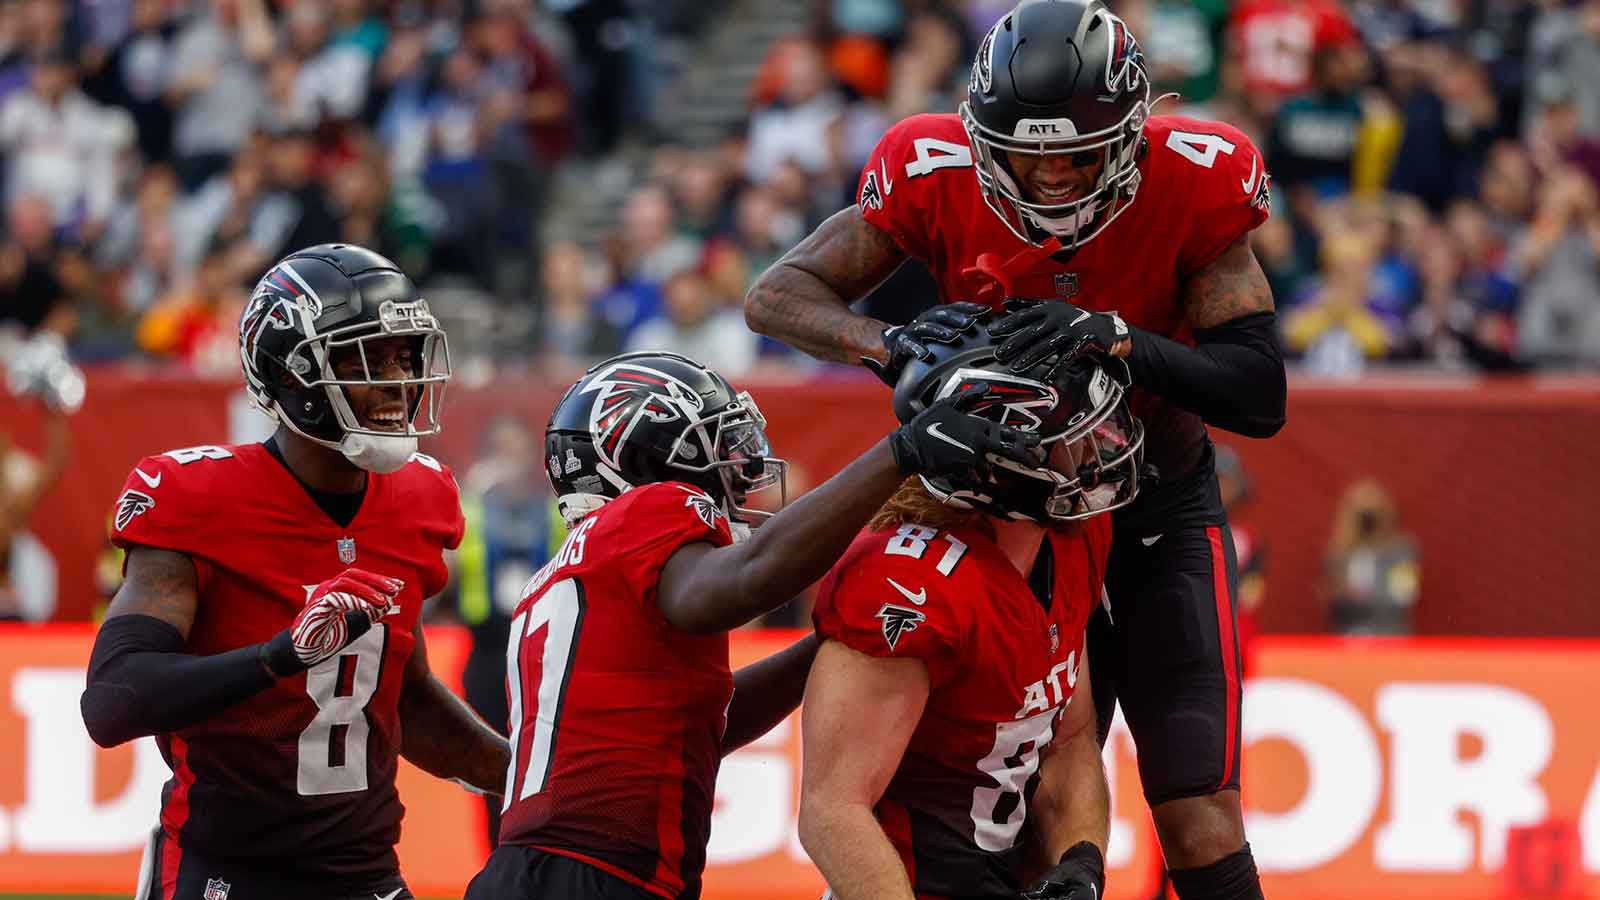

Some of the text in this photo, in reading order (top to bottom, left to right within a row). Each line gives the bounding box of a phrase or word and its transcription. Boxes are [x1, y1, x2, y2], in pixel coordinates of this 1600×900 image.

[1028, 123, 1061, 134] ATL
[1165, 130, 1236, 168] 4
[905, 137, 973, 177] 4
[161, 444, 233, 465] 8
[884, 523, 968, 575] 81
[297, 622, 384, 795] 8
[501, 577, 580, 816] 17
[970, 697, 1072, 852] 8
